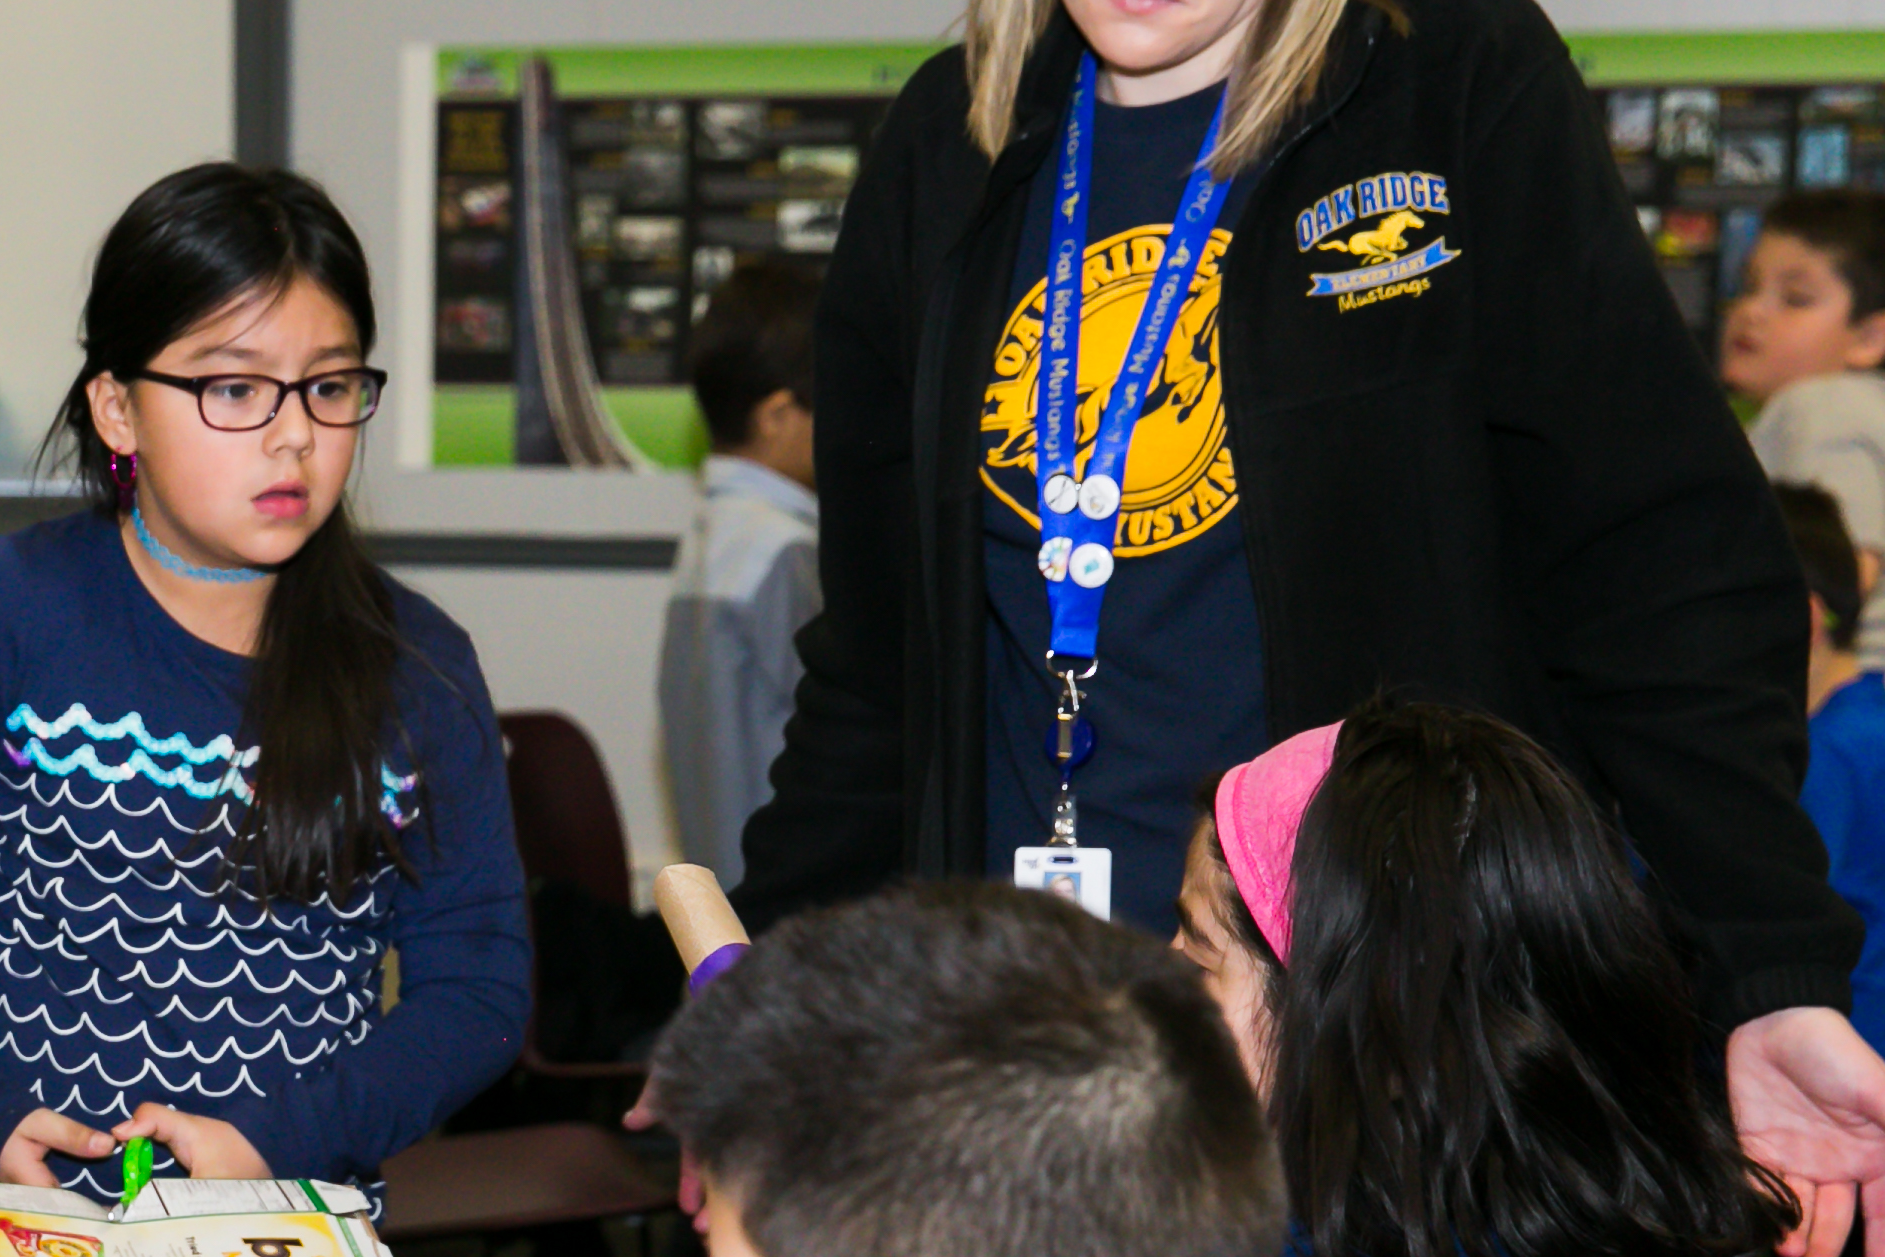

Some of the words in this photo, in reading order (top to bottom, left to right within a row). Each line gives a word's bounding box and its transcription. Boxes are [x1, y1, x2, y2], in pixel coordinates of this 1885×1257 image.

[1296, 184, 1355, 253] OAK
[1356, 171, 1451, 218] RIDGE
[1055, 238, 1076, 286] Oak
[1082, 236, 1227, 297] RIDE
[1048, 288, 1073, 352] Ridge
[1337, 277, 1432, 315] Mustangs
[1044, 357, 1069, 461] Mustangs
